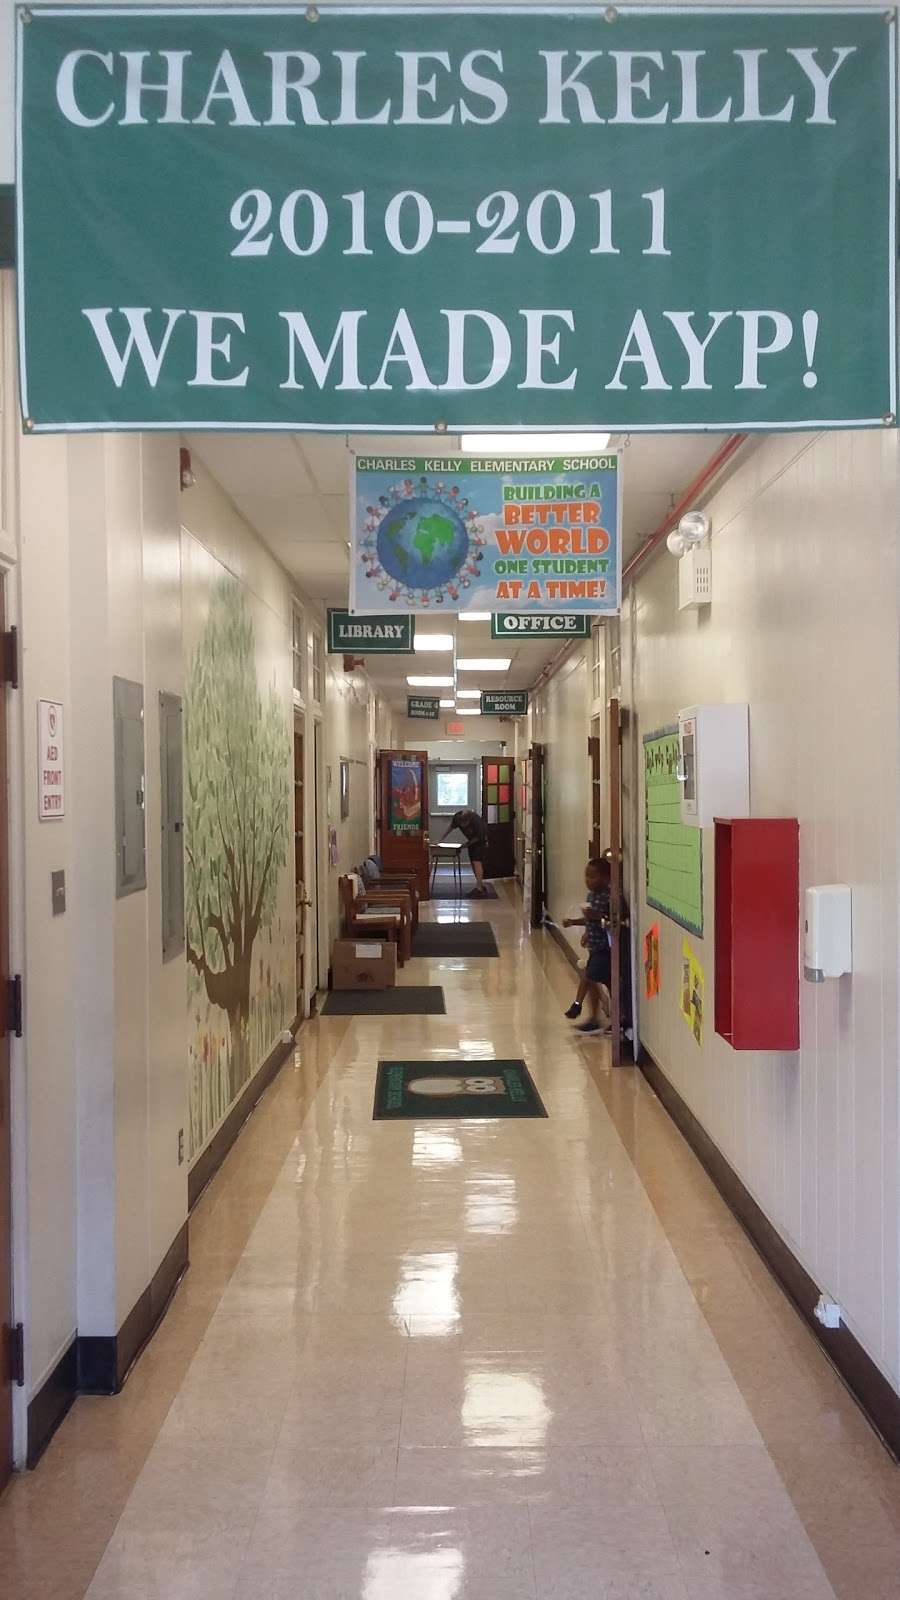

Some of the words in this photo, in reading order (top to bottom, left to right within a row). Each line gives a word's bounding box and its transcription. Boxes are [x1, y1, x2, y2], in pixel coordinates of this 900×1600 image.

[57, 50, 507, 126] CHARLES
[539, 47, 856, 123] KELLY
[231, 189, 671, 256] 2010-2011
[82, 308, 249, 387] WE
[279, 309, 577, 391] MADE
[605, 309, 818, 390] AYP!
[357, 459, 416, 472] CHARLES
[424, 459, 463, 472] KELLY
[470, 459, 555, 472] ELEMENTARY
[563, 458, 616, 471] SCHOOL
[503, 484, 585, 501] BUILDING
[588, 484, 601, 499] A
[504, 503, 600, 526] BETTER
[495, 528, 610, 555] WORLD
[494, 560, 528, 574] ONE
[532, 559, 609, 574] STUDENT
[496, 581, 522, 599] AT
[528, 581, 542, 599] A
[546, 580, 606, 598] TIME!
[503, 615, 577, 630] OFFICE
[339, 624, 405, 639] LIBRARY
[485, 695, 523, 703] RESOURCE
[494, 703, 516, 711] ROOM
[47, 746, 58, 760] AED
[391, 760, 421, 768] WELCOME
[43, 770, 62, 785] FRONT
[44, 795, 62, 810] ENTRY
[393, 823, 420, 831] FRIENDS
